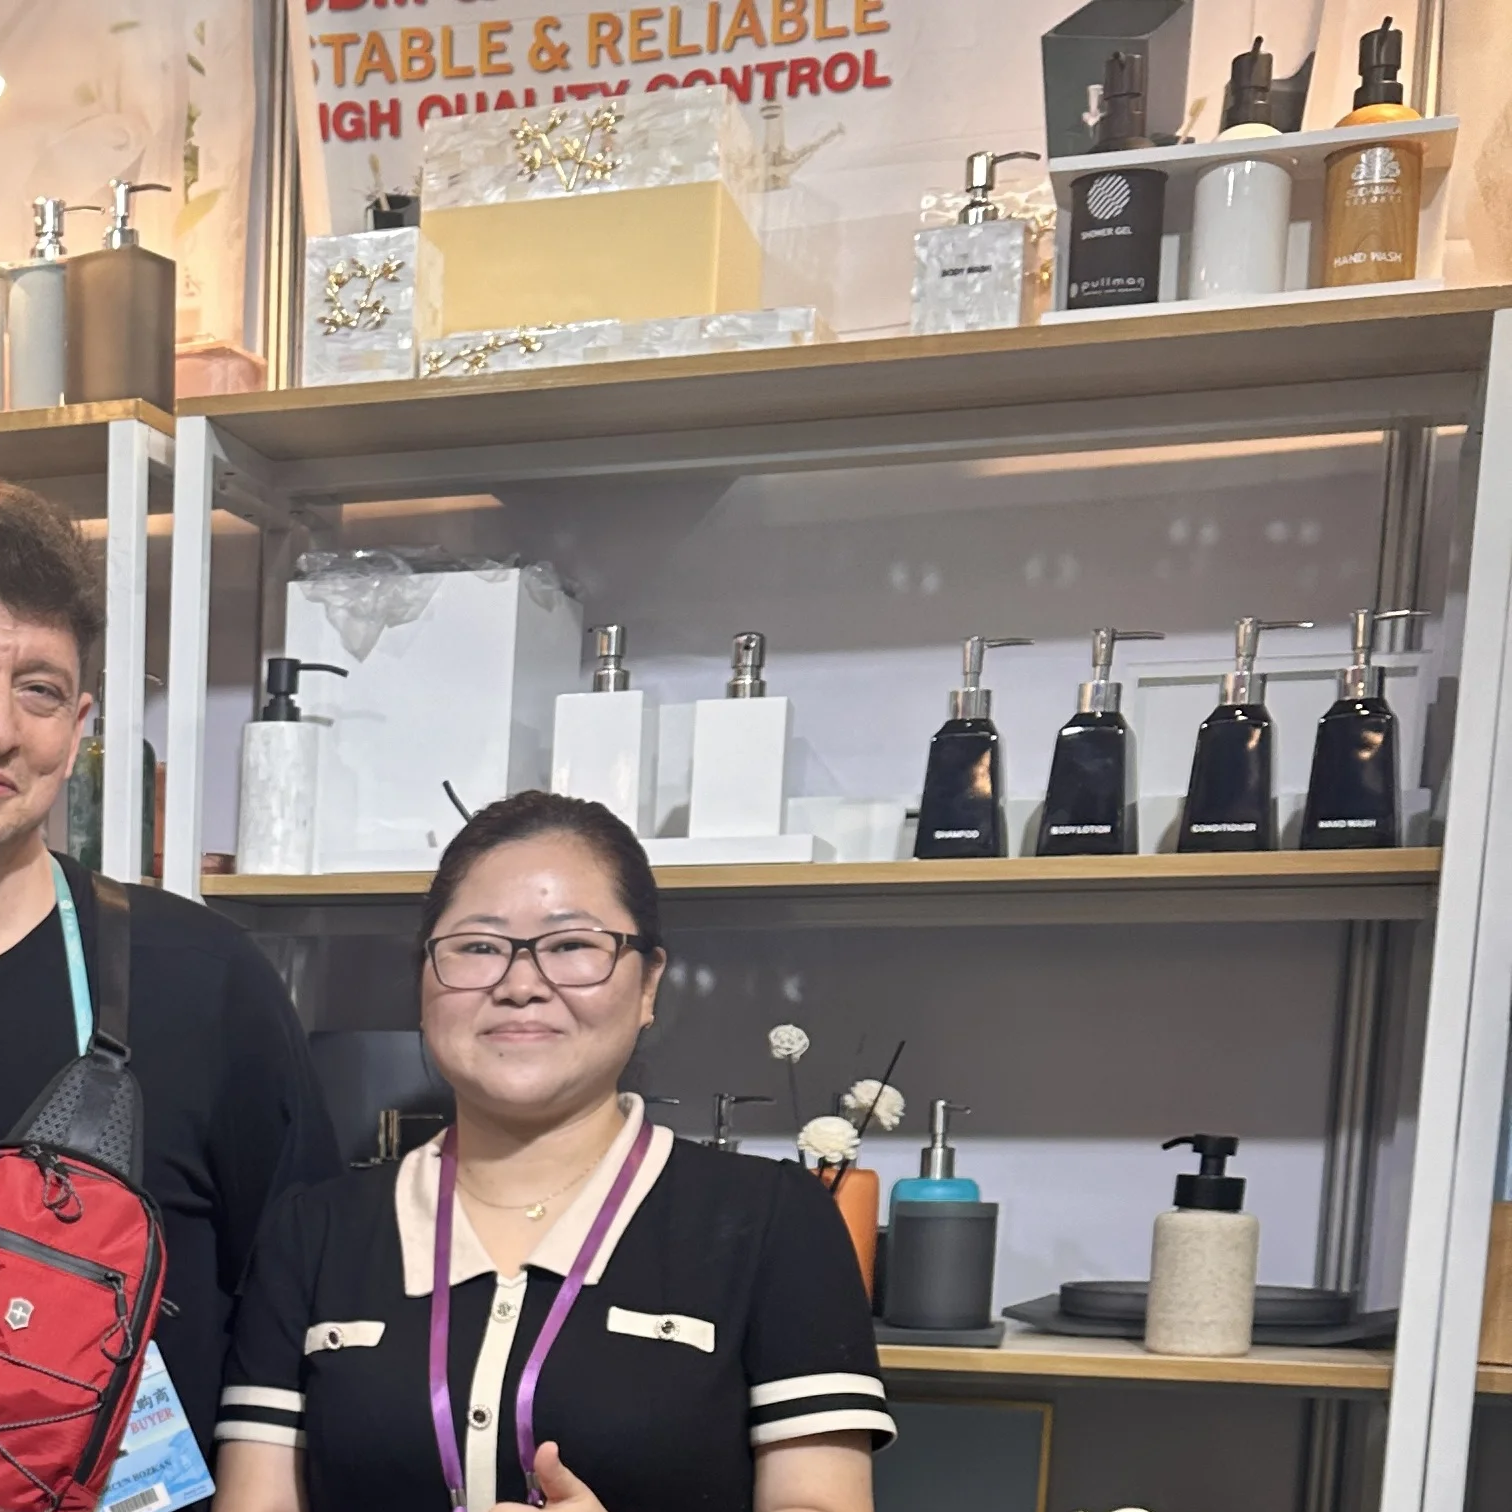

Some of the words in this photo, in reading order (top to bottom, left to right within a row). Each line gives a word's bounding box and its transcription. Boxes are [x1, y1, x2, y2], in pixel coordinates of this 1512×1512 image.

[309, 20, 514, 87] TABLE
[528, 15, 570, 72] &
[588, 0, 891, 67] RELIABLE
[1114, 226, 1134, 235] GEL
[1333, 251, 1367, 268] HAND
[1370, 251, 1402, 263] WASH
[129, 1407, 175, 1435] BUYER
